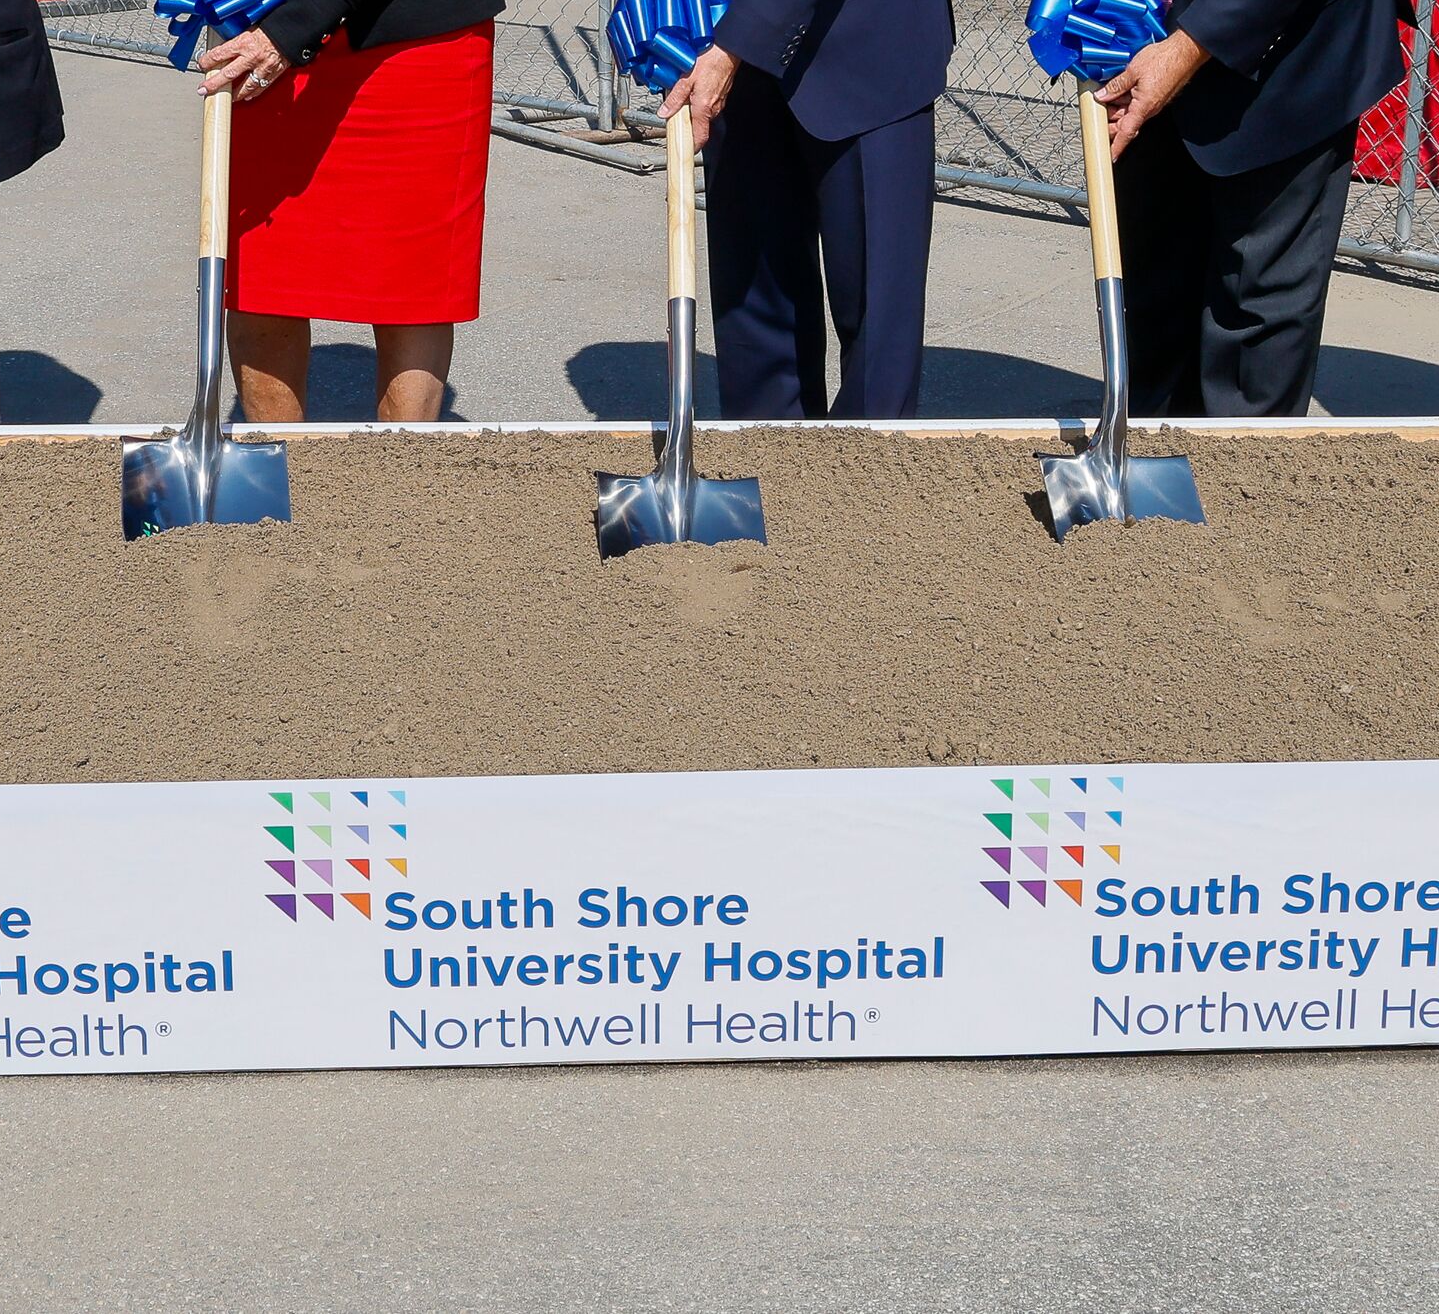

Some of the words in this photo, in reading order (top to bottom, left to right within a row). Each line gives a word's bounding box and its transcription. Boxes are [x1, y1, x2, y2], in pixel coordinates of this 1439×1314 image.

[385, 888, 553, 931] South
[577, 886, 748, 928] Shore
[1095, 875, 1259, 917] South
[384, 943, 681, 991] University
[705, 937, 944, 989] Hospital
[1092, 929, 1380, 977] University
[390, 1003, 660, 1050] Northwell
[1093, 987, 1357, 1036] Northwell
